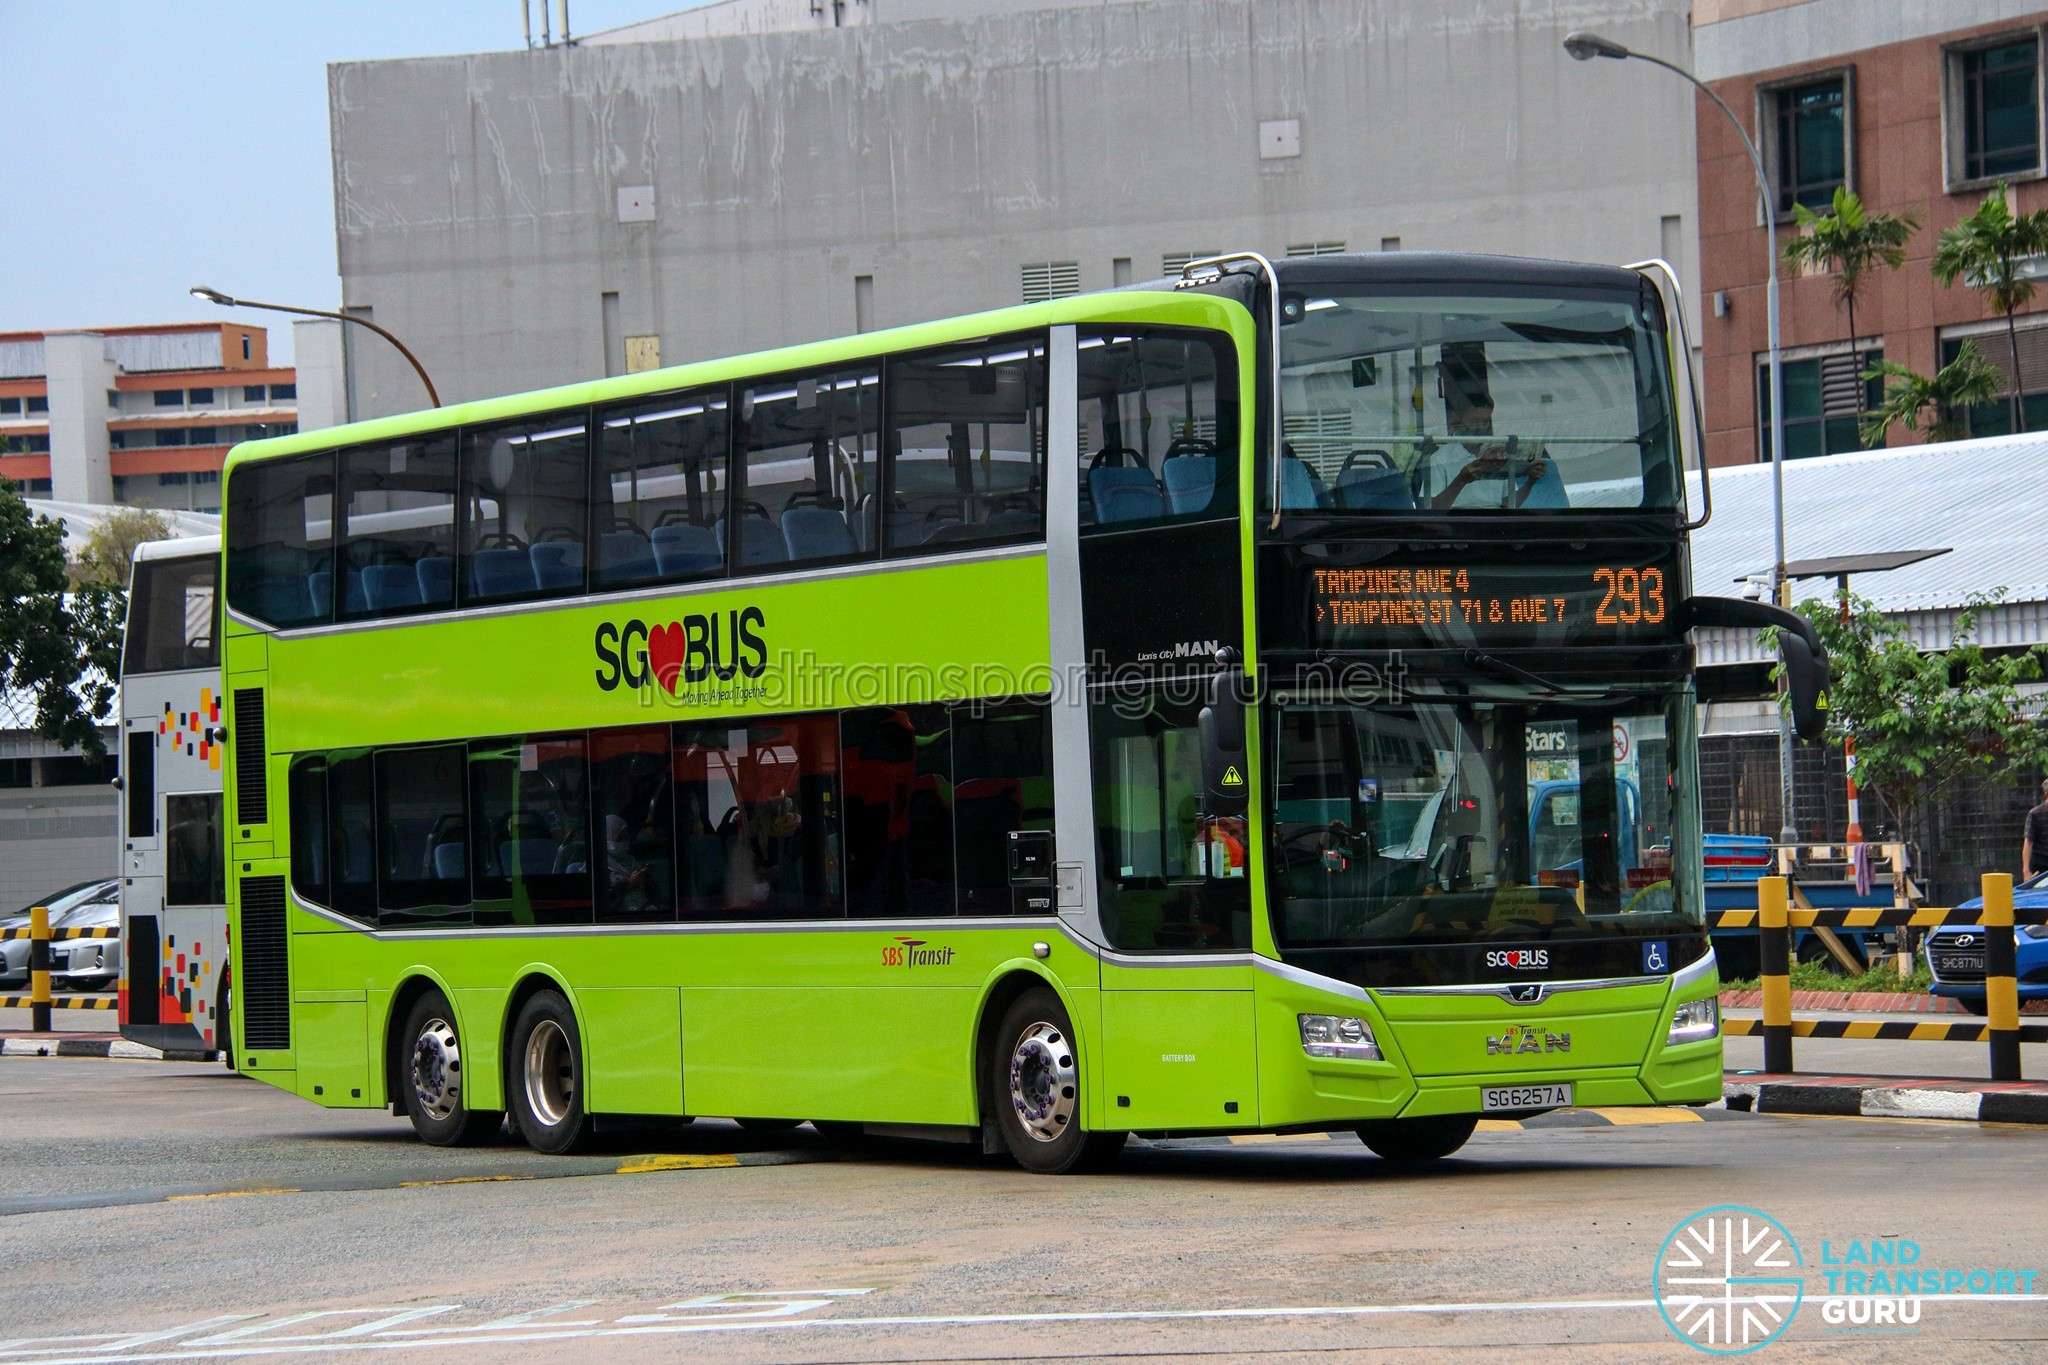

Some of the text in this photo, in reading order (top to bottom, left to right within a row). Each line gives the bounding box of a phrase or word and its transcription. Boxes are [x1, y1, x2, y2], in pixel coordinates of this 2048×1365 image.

[1314, 569, 1470, 594] TAMPINES AVE 4
[1592, 567, 1665, 625] 293
[1329, 598, 1566, 624] TAMPINES ST 71 & AVE 7
[1159, 650, 1175, 660] City
[1175, 640, 1219, 658] MAN
[683, 686, 767, 706] Moving Ahead Together
[882, 940, 956, 970] SBS Transit
[1941, 957, 1984, 969] SHC8771U
[1505, 1024, 1548, 1036] SBS Transit
[1487, 1032, 1571, 1056] MAN
[1161, 1054, 1196, 1063] BATTERY BOX
[1488, 1086, 1566, 1108] SG6257A
